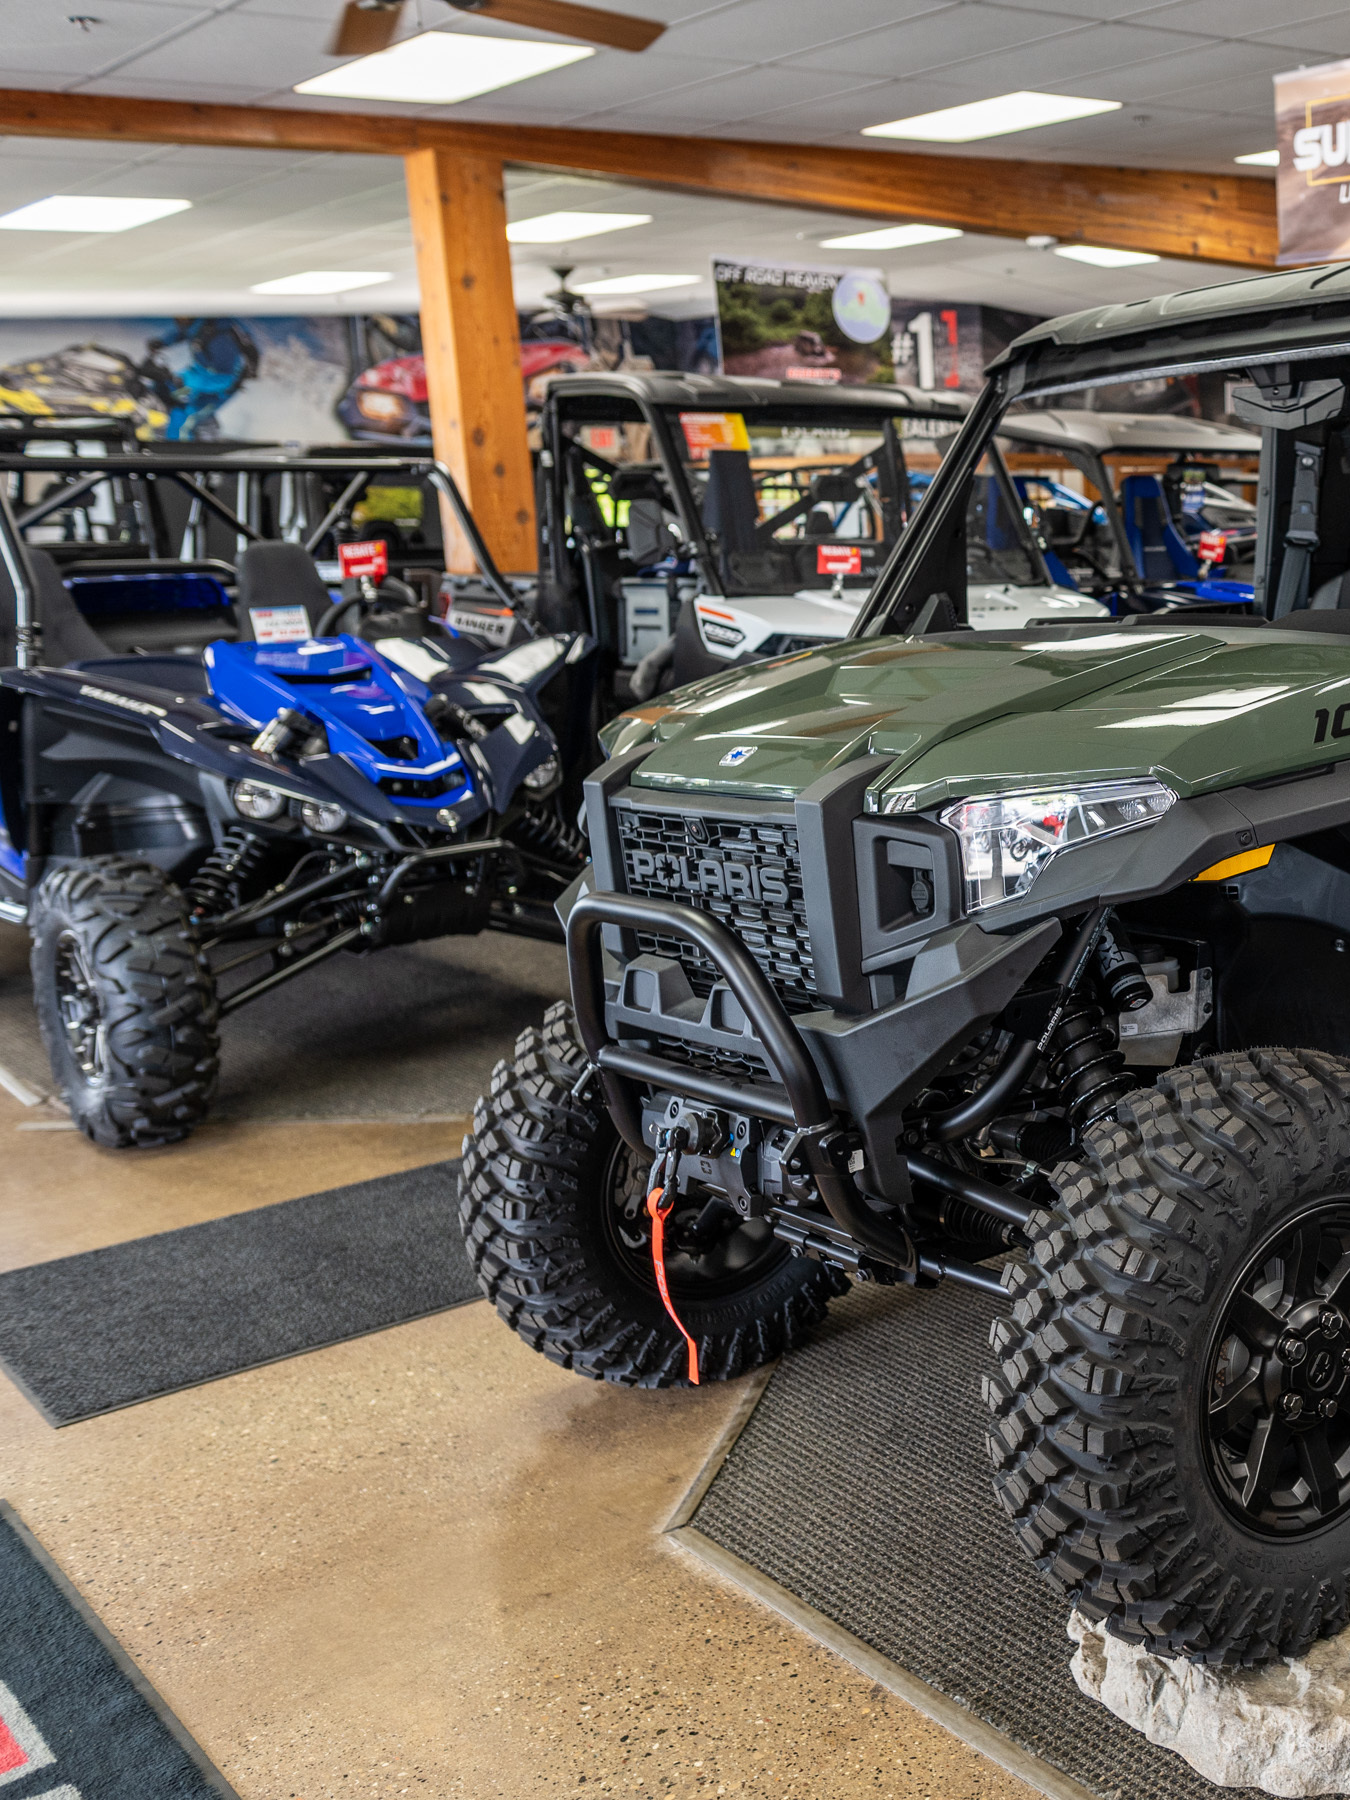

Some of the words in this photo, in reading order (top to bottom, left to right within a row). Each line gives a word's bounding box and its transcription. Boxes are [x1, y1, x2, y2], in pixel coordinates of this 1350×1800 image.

[715, 264, 742, 283] OFF
[744, 267, 783, 287] ROAD
[454, 616, 506, 636] RANGER
[704, 622, 744, 644] 1000
[632, 849, 790, 904] POLARIS
[1036, 1006, 1063, 1052] POLARIS
